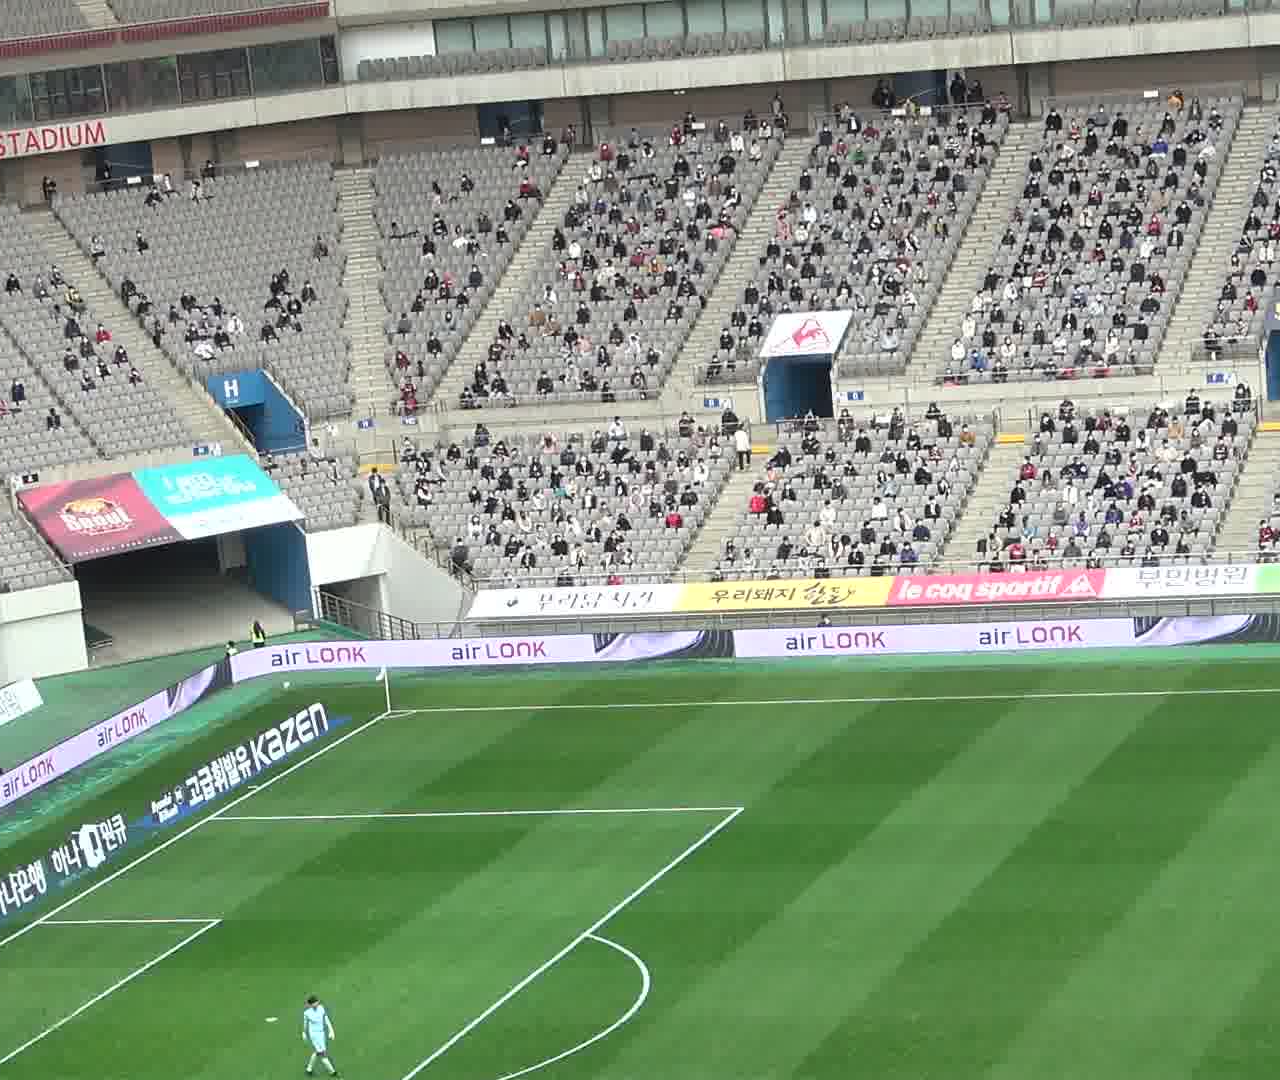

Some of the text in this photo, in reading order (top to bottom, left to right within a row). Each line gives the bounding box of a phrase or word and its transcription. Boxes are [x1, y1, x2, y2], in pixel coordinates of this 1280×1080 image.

[224, 379, 239, 398] H
[711, 587, 796, 603] 우리돼지
[897, 573, 1064, 600] le coq sportif
